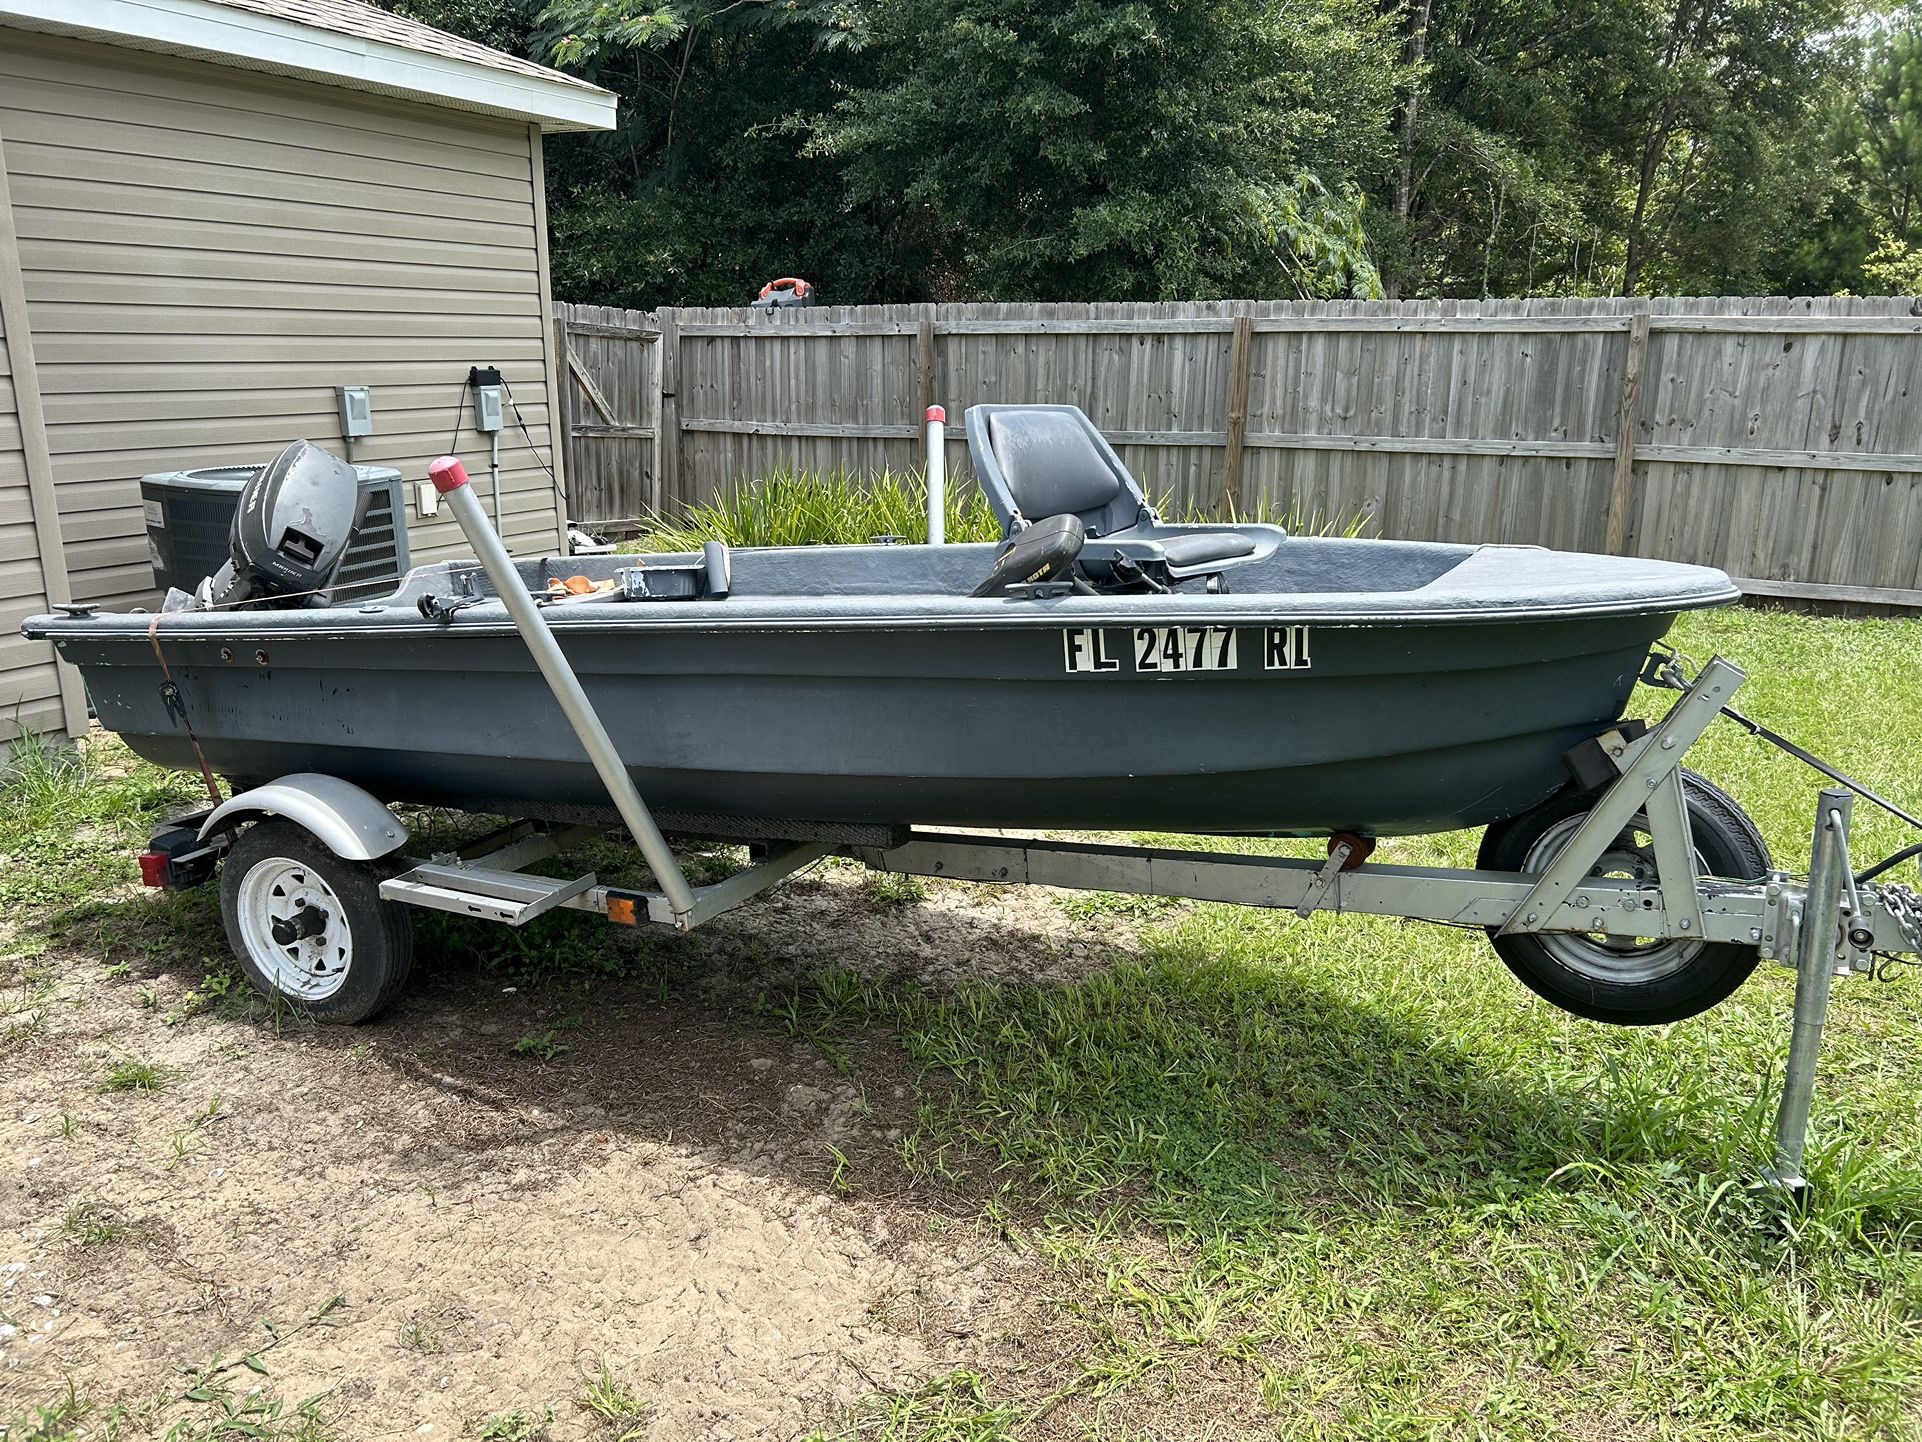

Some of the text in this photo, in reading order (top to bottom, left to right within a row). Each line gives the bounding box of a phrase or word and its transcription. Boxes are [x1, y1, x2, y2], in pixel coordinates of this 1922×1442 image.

[1066, 627, 1310, 671] FL 2477 RL
